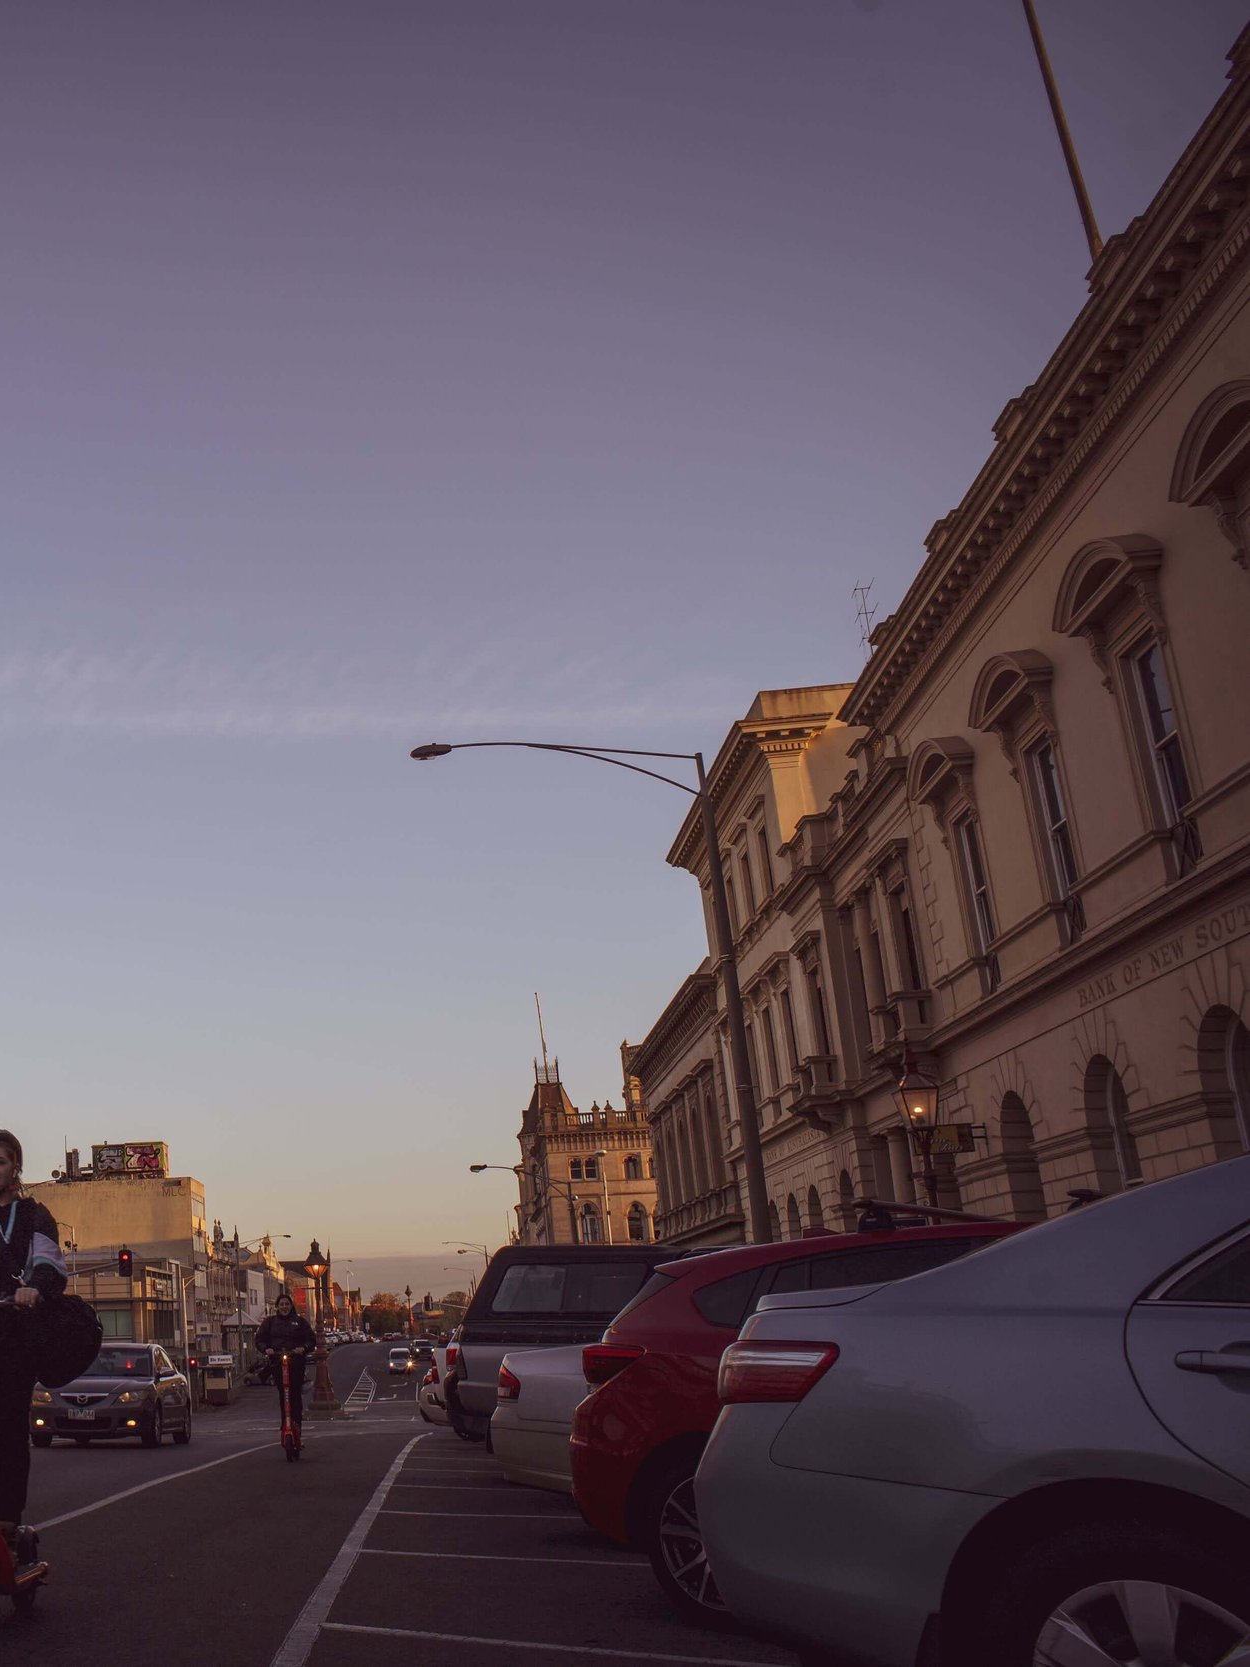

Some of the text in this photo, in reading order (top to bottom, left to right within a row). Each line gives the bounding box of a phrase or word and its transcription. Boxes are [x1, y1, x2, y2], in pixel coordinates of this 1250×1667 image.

[1077, 973, 1117, 1008] BANK
[1123, 958, 1142, 986] OF
[1148, 935, 1184, 973] NEW
[161, 1186, 186, 1197] MLC
